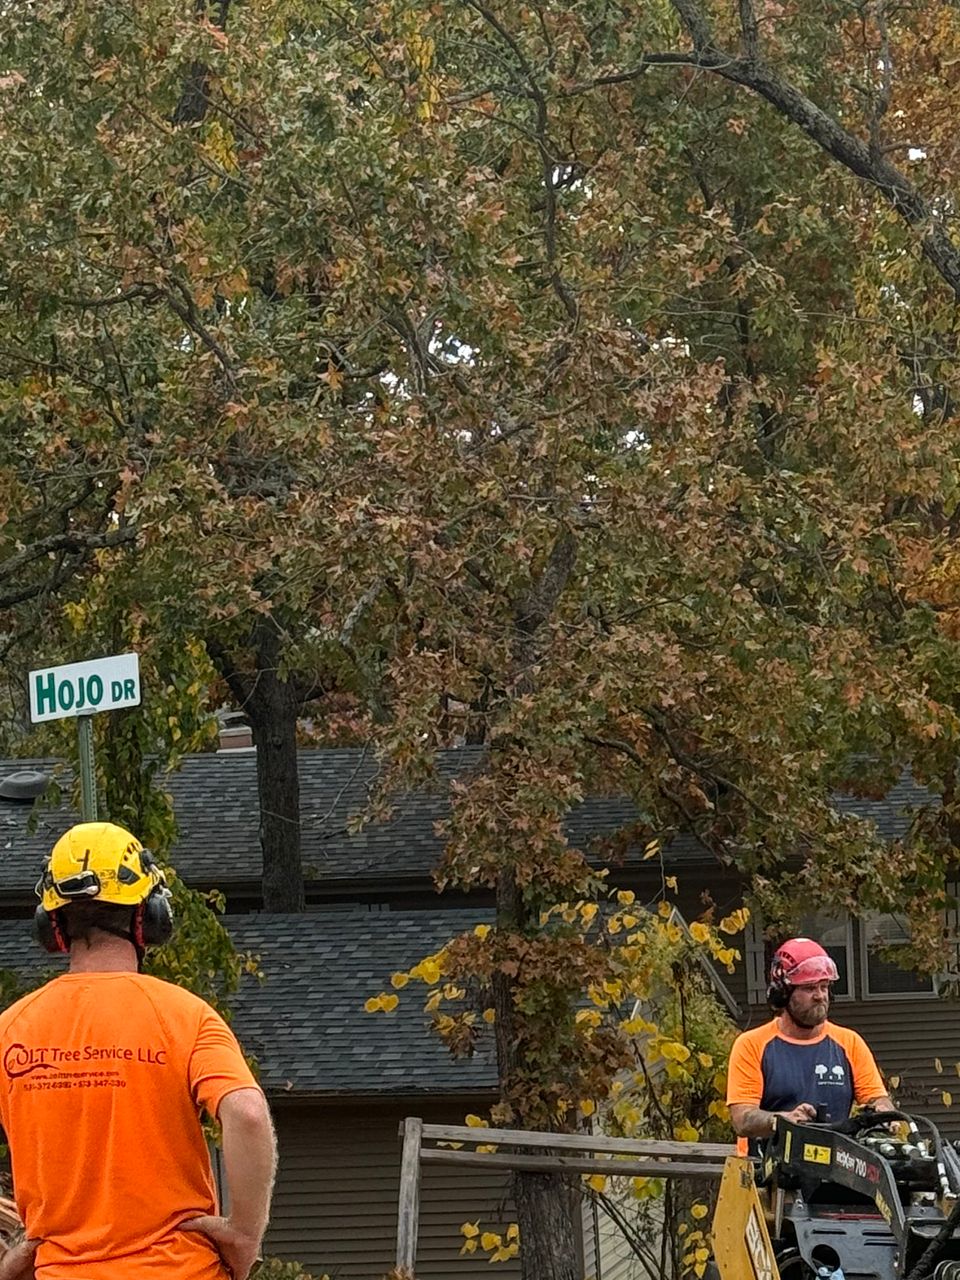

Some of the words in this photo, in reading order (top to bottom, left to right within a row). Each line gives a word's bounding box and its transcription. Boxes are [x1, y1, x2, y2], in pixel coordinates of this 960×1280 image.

[36, 672, 103, 715] HOJO
[111, 679, 136, 702] DR
[50, 1048, 81, 1061] Tree
[83, 1045, 133, 1061] Service
[138, 1047, 167, 1065] LLC
